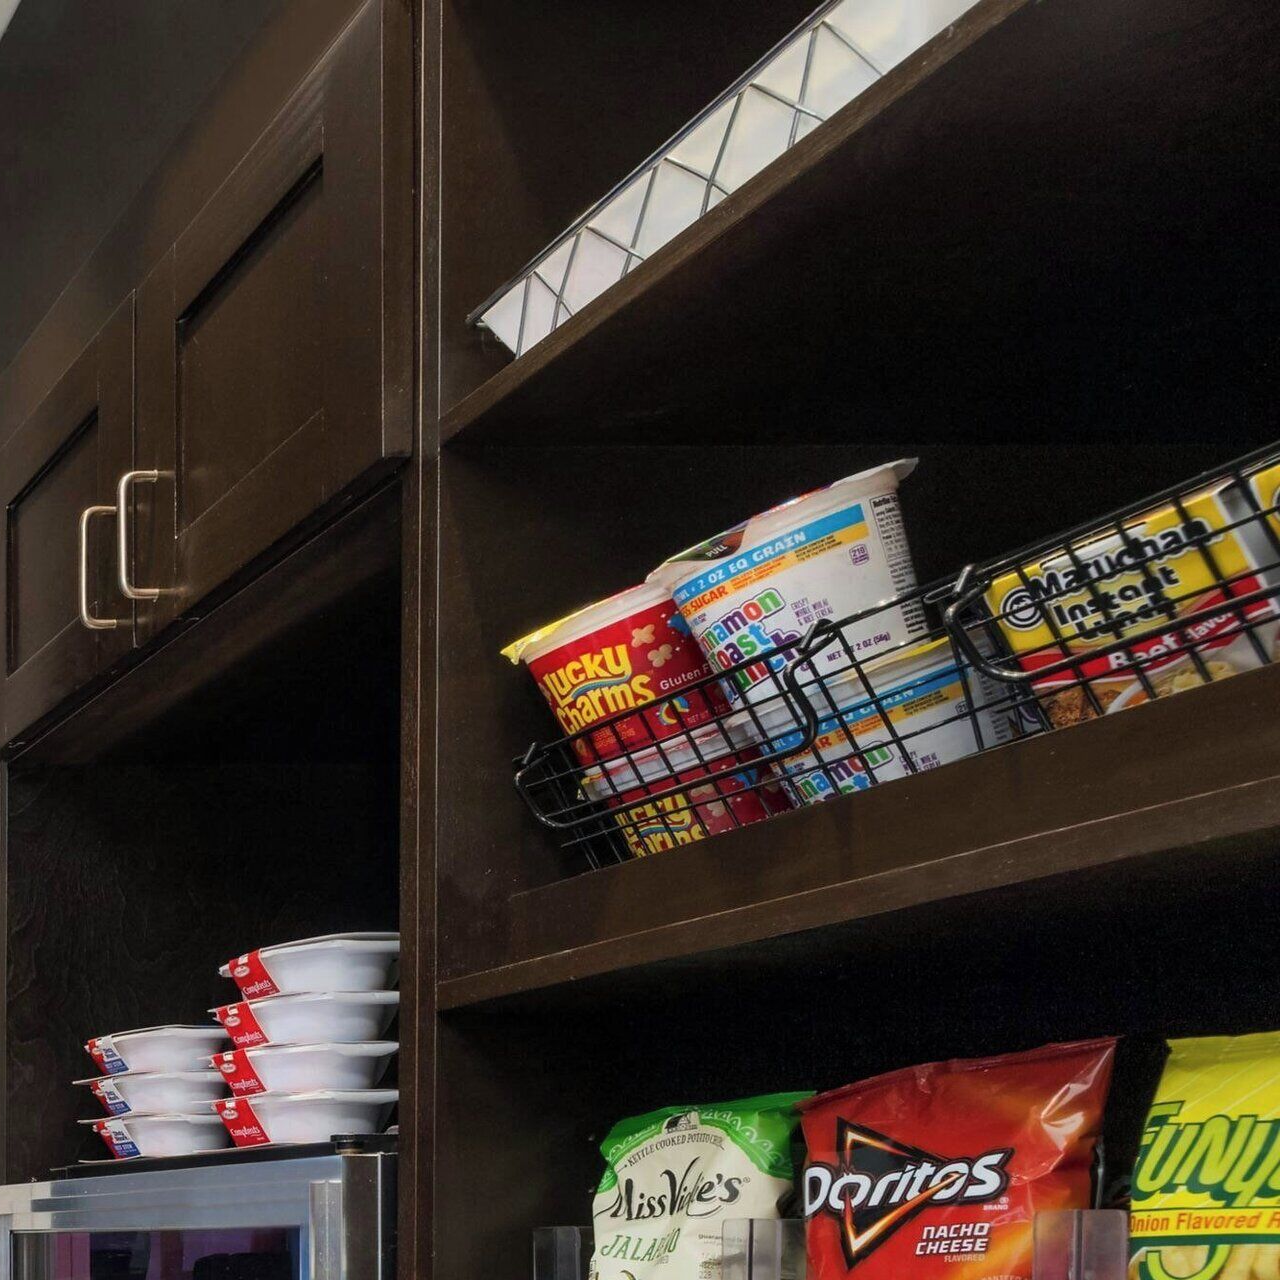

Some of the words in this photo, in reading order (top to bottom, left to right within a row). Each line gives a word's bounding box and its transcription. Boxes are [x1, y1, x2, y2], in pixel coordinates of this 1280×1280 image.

[697, 579, 706, 590] 2
[707, 569, 726, 584] OZ
[728, 558, 749, 575] EQ
[751, 531, 807, 562] GRAIN
[705, 543, 728, 558] PULL
[1031, 518, 1211, 597] Maruchan
[690, 585, 729, 611] SUGAR
[826, 650, 842, 663] NET
[862, 638, 873, 650] OZ
[873, 631, 892, 648] (56g)
[544, 643, 629, 702] Lucky
[659, 669, 701, 691] Gluten
[554, 674, 656, 735] Charms
[627, 1145, 655, 1167] KETTLE
[655, 1135, 687, 1151] COOKED
[805, 1148, 1012, 1217] Doritos
[921, 1222, 991, 1239] NACHO
[1175, 1212, 1260, 1231] Flavored
[915, 1238, 990, 1256] CHEESE
[943, 1253, 986, 1263] FLAVORED
